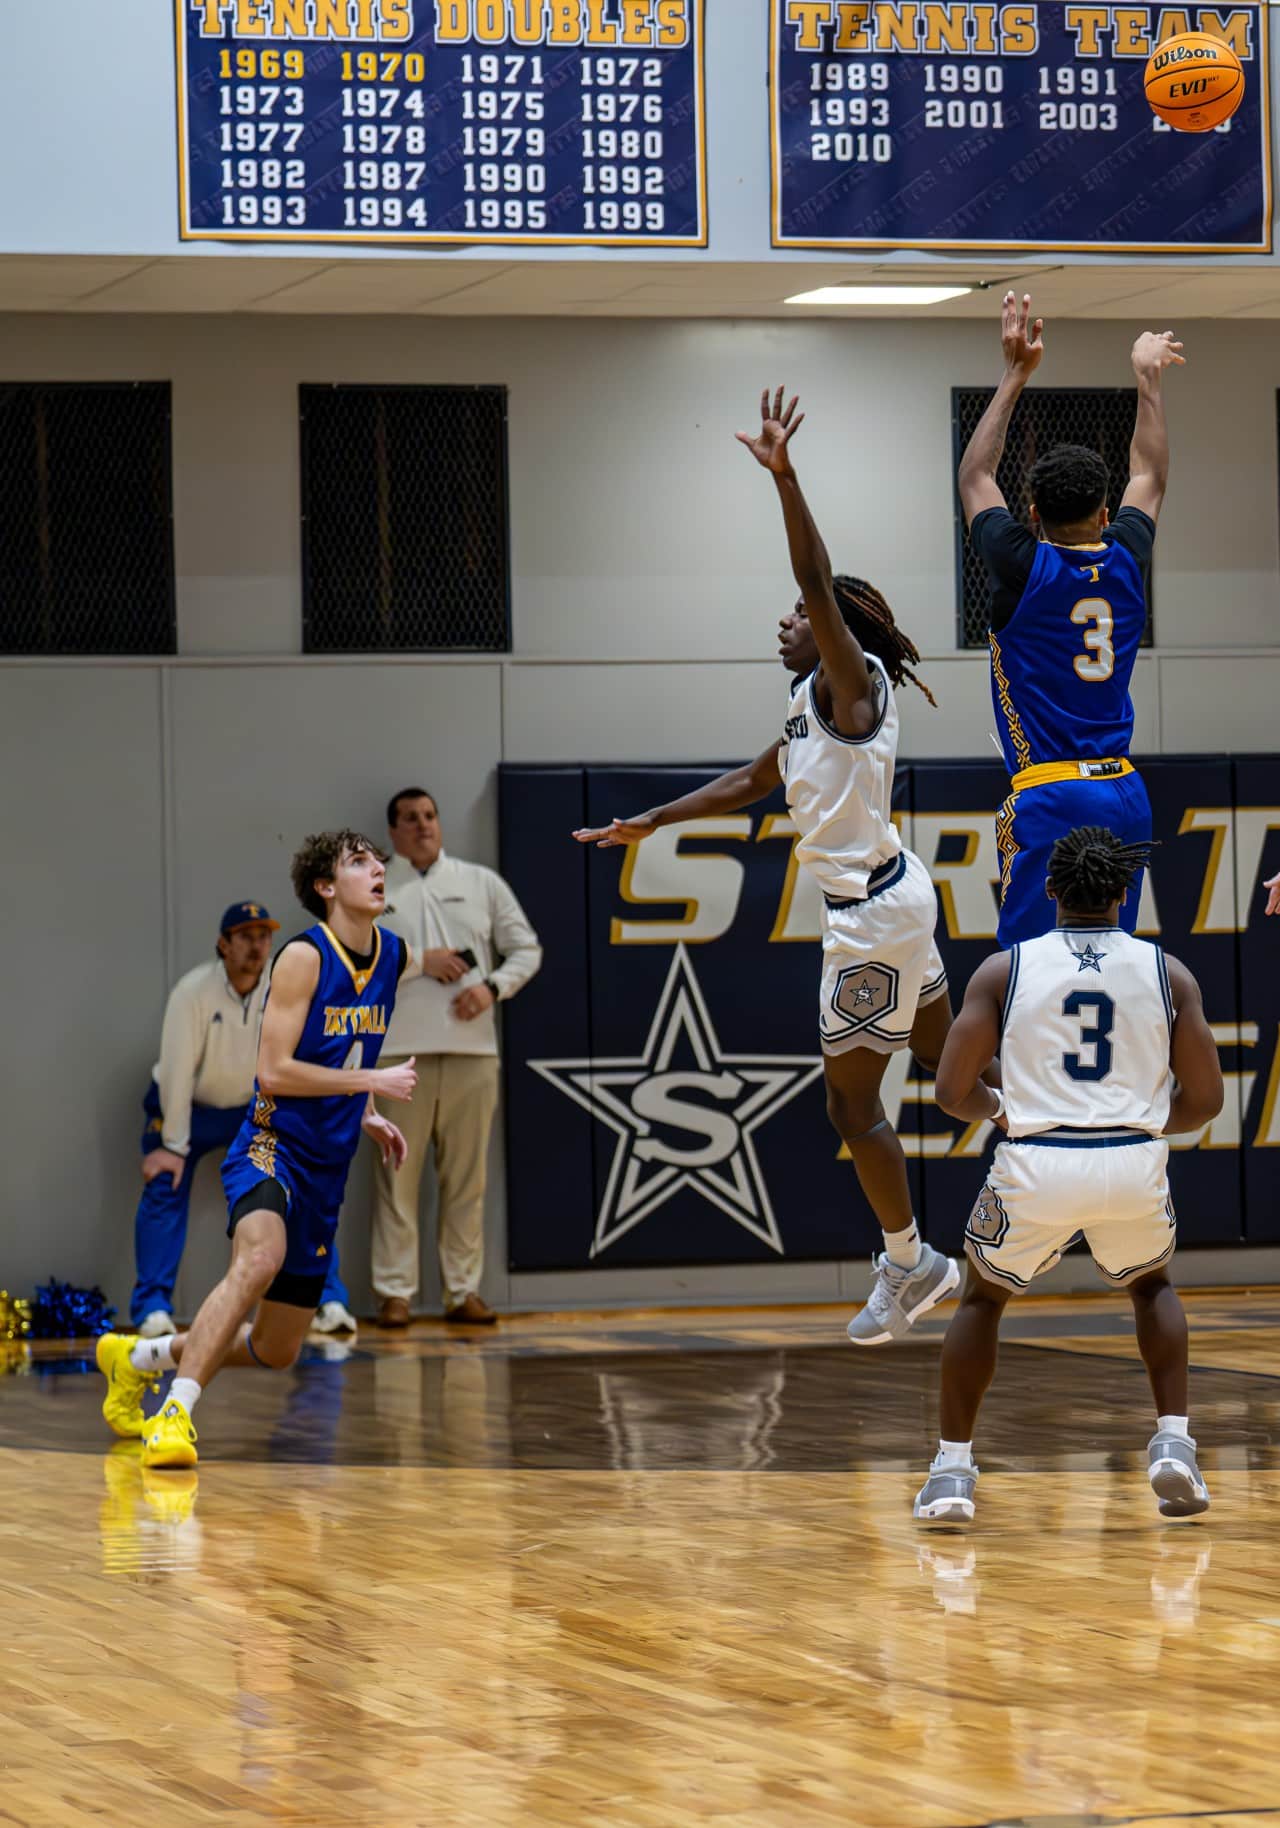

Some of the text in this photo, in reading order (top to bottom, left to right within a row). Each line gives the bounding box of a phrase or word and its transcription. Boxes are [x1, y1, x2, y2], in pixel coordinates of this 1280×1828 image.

[191, 0, 690, 49] TENNIS DOUBLES
[786, 2, 1253, 60] TENNIS TEAM
[220, 49, 661, 86] 1969 1970 1971 1972
[1153, 46, 1217, 71] Wilson
[811, 63, 1116, 95] 1989 1990 1991
[221, 86, 661, 122] 1973 1974 1975 1976
[810, 98, 1117, 130] 1993 2001 2003
[221, 123, 662, 158] 1977 1978 1979 1980
[811, 133, 890, 161] 2010
[222, 159, 663, 194] 1982 1987 1990 1992
[223, 196, 664, 230] 1993 1994 1995 1999
[1079, 563, 1104, 582] T
[1070, 597, 1115, 682] 3
[1062, 988, 1116, 1083] 3
[631, 1070, 745, 1168] S
